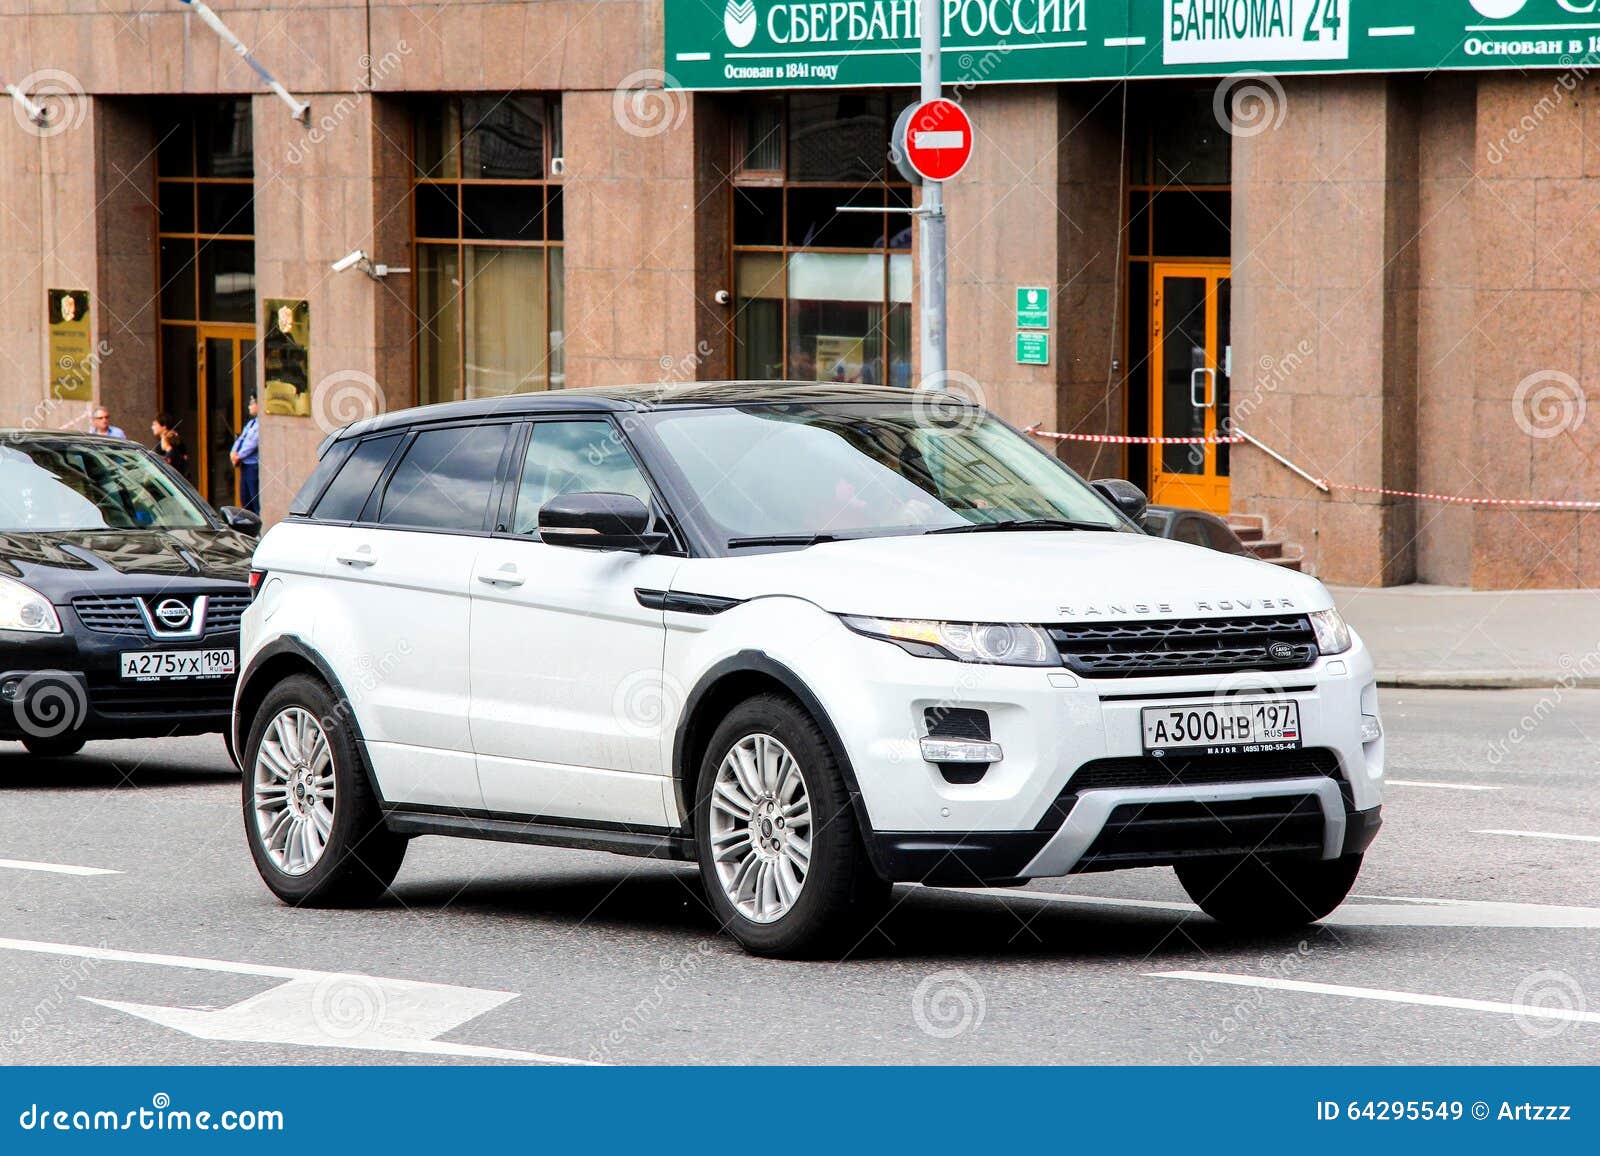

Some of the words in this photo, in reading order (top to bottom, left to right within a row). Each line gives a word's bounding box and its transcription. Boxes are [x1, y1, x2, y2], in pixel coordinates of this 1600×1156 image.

[942, 0, 1087, 37] РОССИИ
[1302, 0, 1341, 41] 24
[1464, 38, 1562, 55] Основан
[1568, 40, 1583, 53] в
[724, 64, 774, 79] Основан
[776, 67, 784, 78] в
[786, 62, 809, 77] 1841
[810, 65, 839, 80] году
[1057, 603, 1173, 617] RANGE
[1197, 598, 1294, 611] ROVER
[204, 651, 230, 666] 190
[1256, 705, 1290, 729] 197
[1264, 728, 1284, 738] RUS
